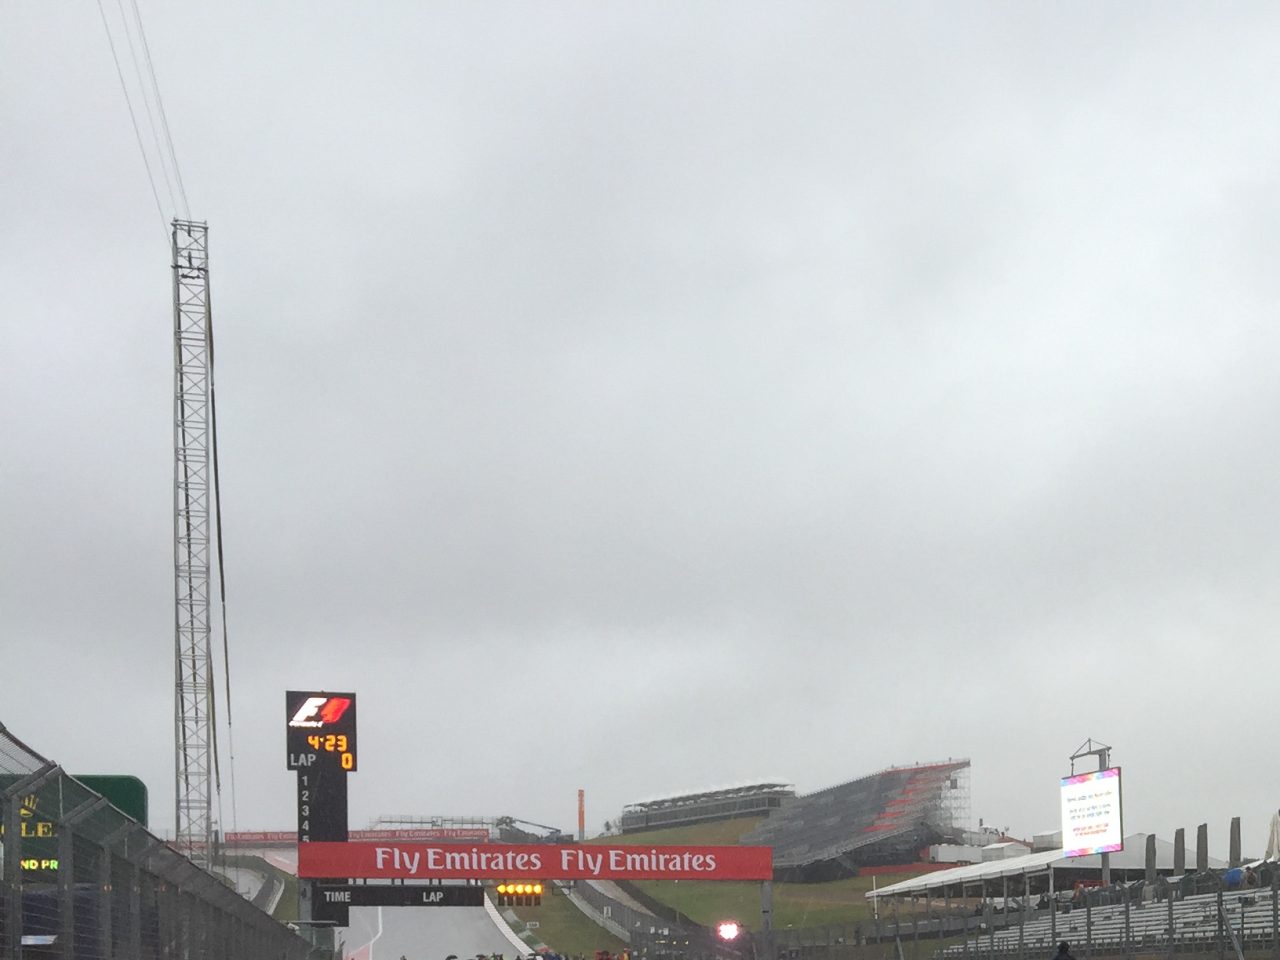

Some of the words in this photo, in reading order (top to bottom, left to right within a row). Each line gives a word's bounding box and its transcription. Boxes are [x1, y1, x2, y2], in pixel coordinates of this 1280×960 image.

[290, 753, 316, 766] LAP
[342, 752, 353, 769] 0
[302, 775, 308, 786] 1
[302, 790, 309, 801] 2
[302, 805, 309, 816] 3
[302, 820, 309, 831] 4
[375, 848, 420, 874] Fly
[426, 848, 542, 870] Emirates
[561, 849, 603, 875] Fly
[609, 849, 716, 871] Emirates
[324, 891, 351, 902] TIME
[422, 891, 444, 902] LAP
